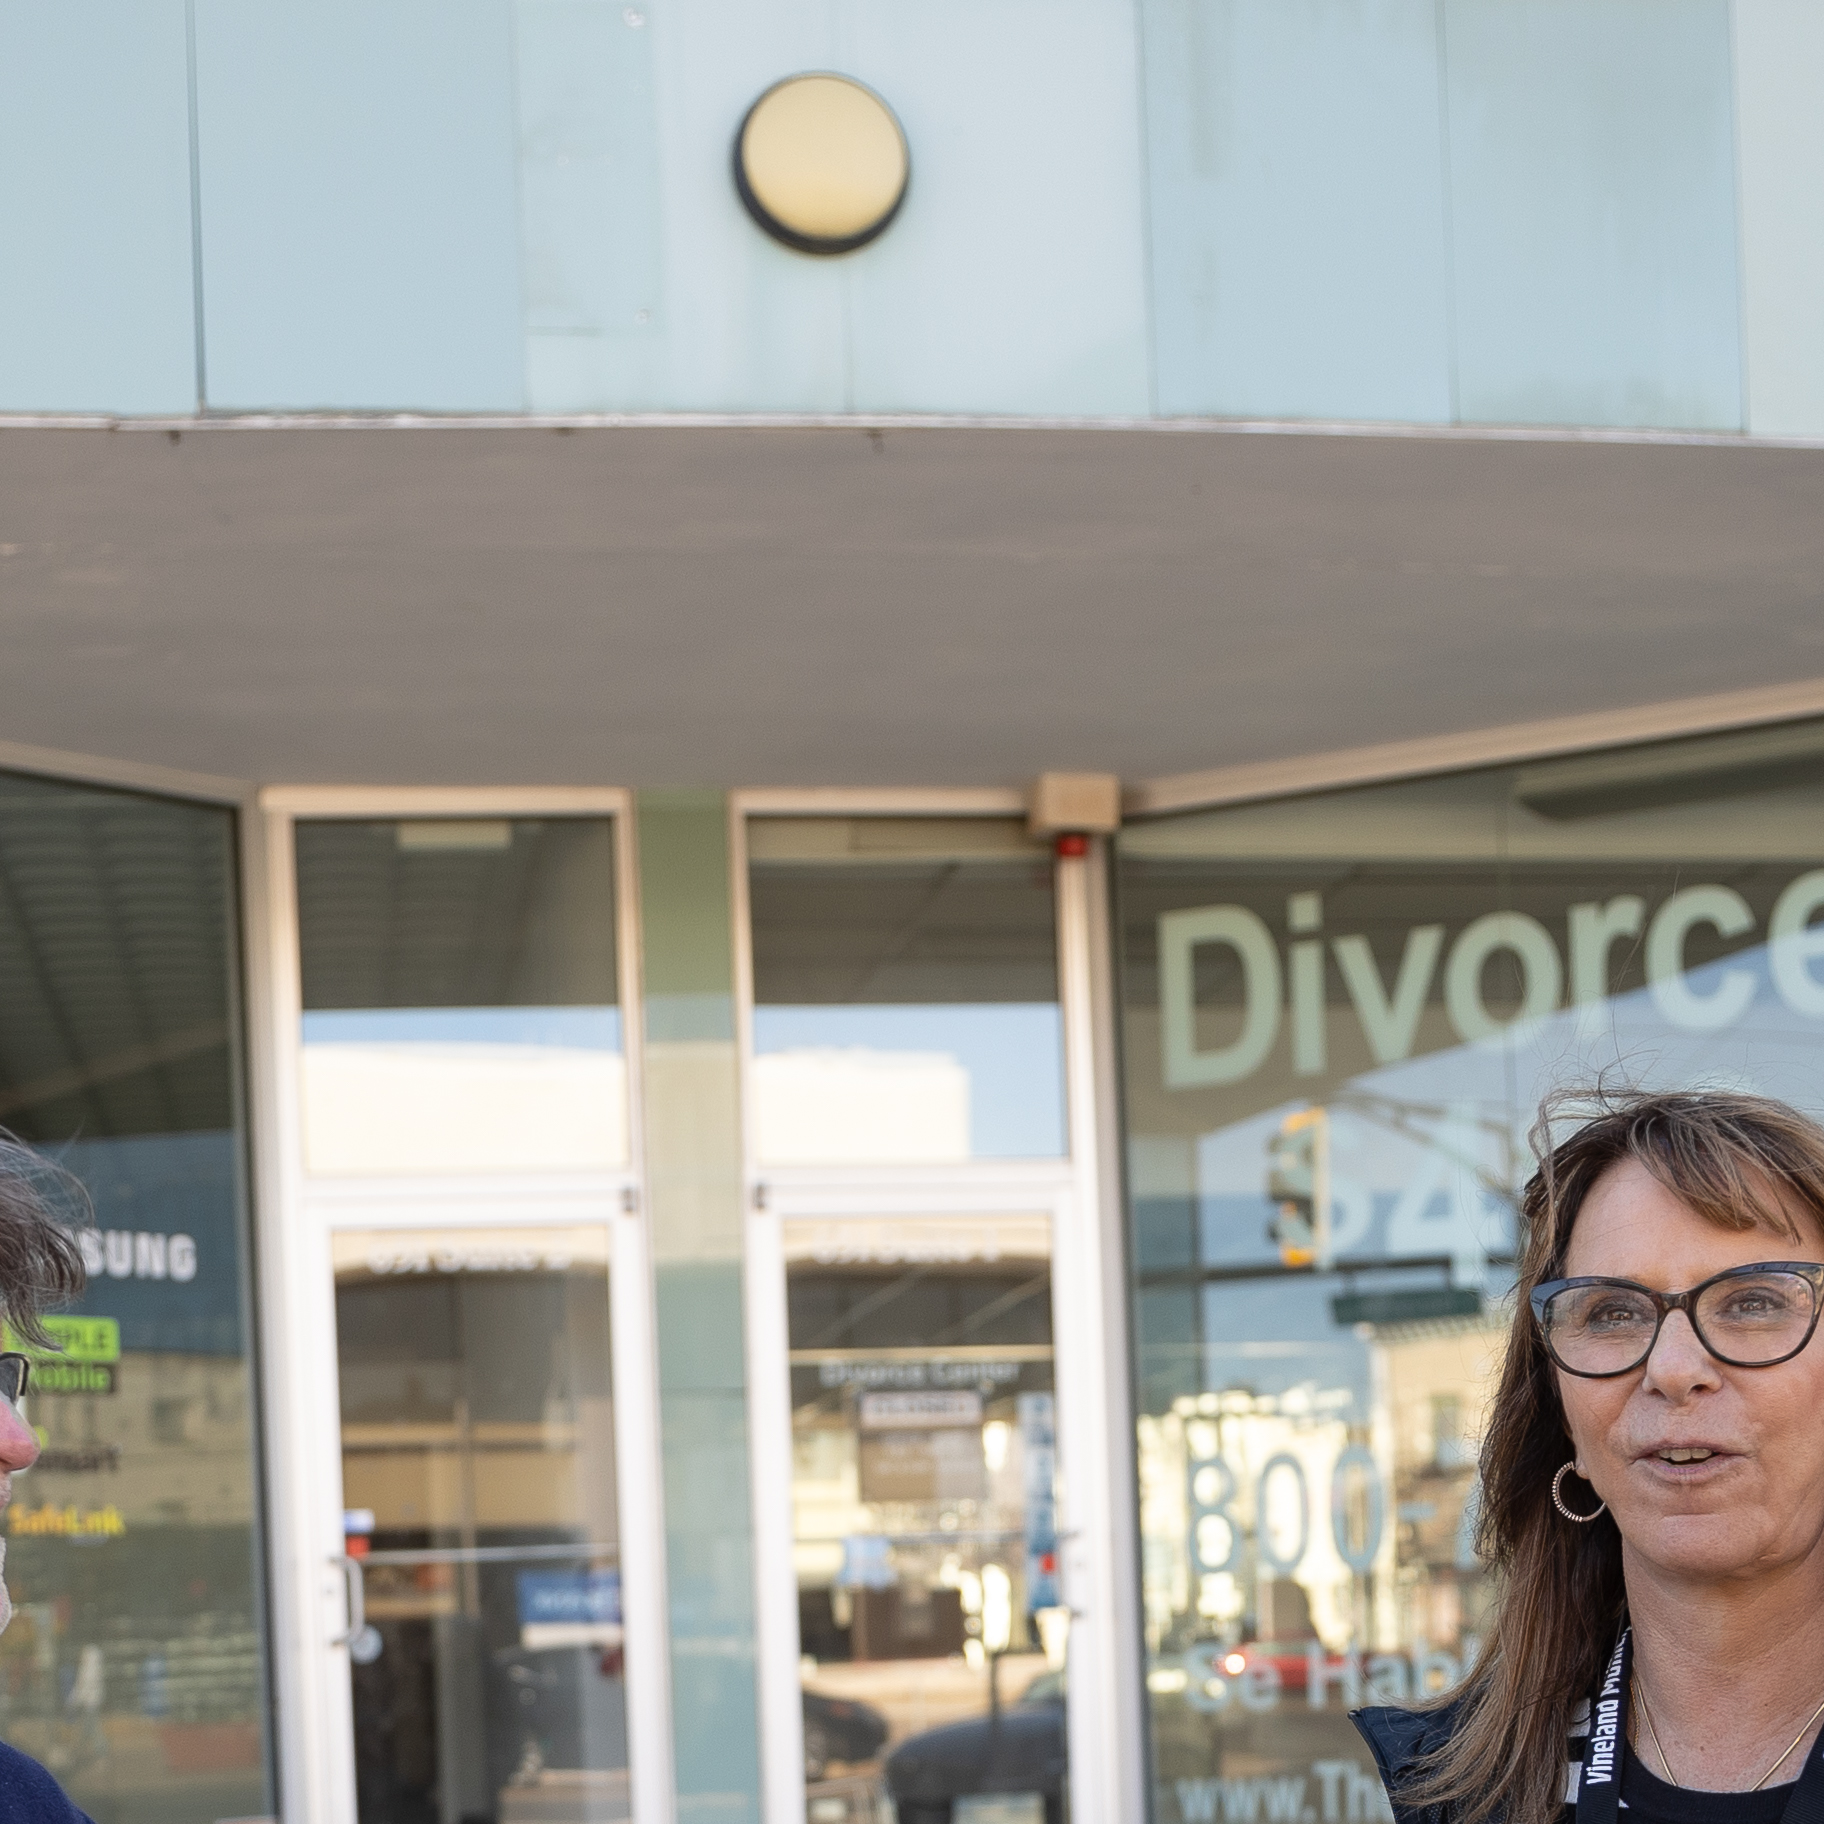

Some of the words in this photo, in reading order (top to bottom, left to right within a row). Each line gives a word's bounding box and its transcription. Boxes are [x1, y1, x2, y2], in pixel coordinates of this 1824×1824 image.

[65, 1227, 198, 1283] SUNG
[1182, 1641, 1282, 1713] Se
[1586, 1699, 1620, 1785] Vineland
